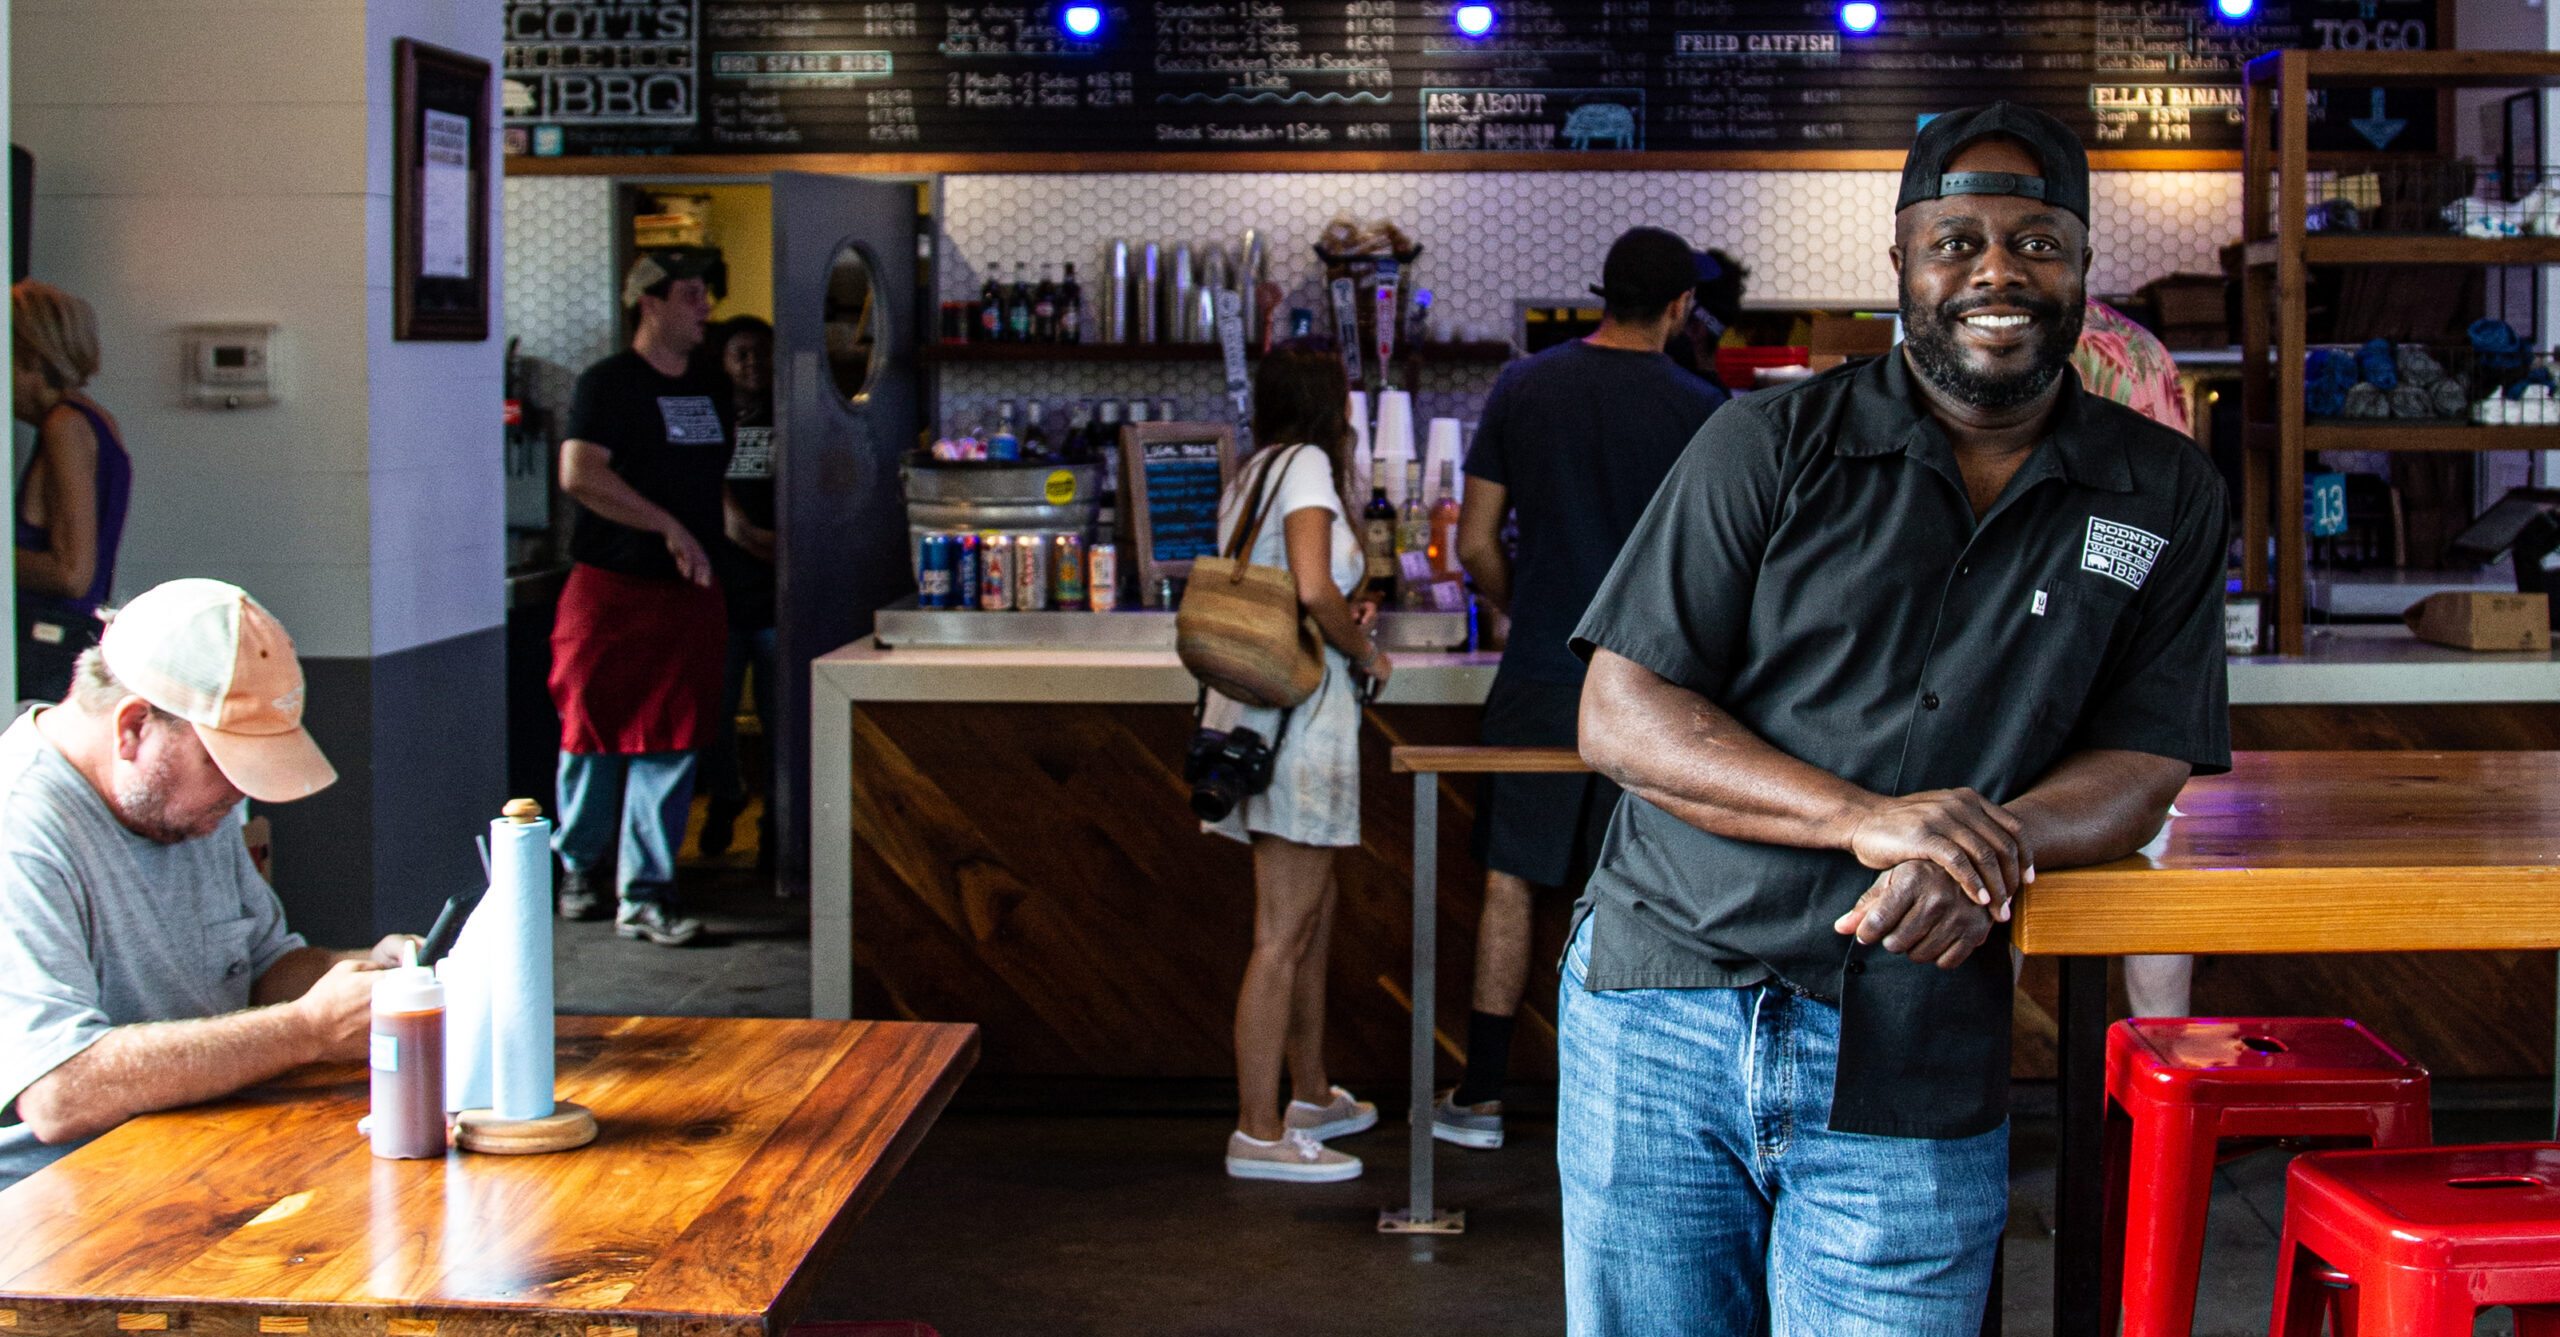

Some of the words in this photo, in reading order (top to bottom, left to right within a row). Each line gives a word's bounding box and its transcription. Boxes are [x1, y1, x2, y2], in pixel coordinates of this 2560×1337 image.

[1680, 34, 1740, 52] FRIED
[1746, 34, 1835, 52] CATFISH
[503, 46, 604, 68] HOLE
[614, 46, 691, 68] HOG
[720, 55, 758, 72] BBQ
[765, 55, 832, 72] SPARE
[840, 55, 887, 72] RIBS
[1319, 52, 1390, 69] Sandwich
[553, 75, 687, 116] BBQ
[1472, 93, 1547, 114] ABOUT
[2096, 87, 2163, 105] ELLA'S
[2168, 87, 2244, 105] BANANA
[1206, 123, 1275, 140] Sandwich
[2317, 485, 2344, 526] 13
[2093, 521, 2159, 549] RODNEY
[2090, 543, 2133, 561] WHOLE
[2114, 562, 2144, 585] BBQ
